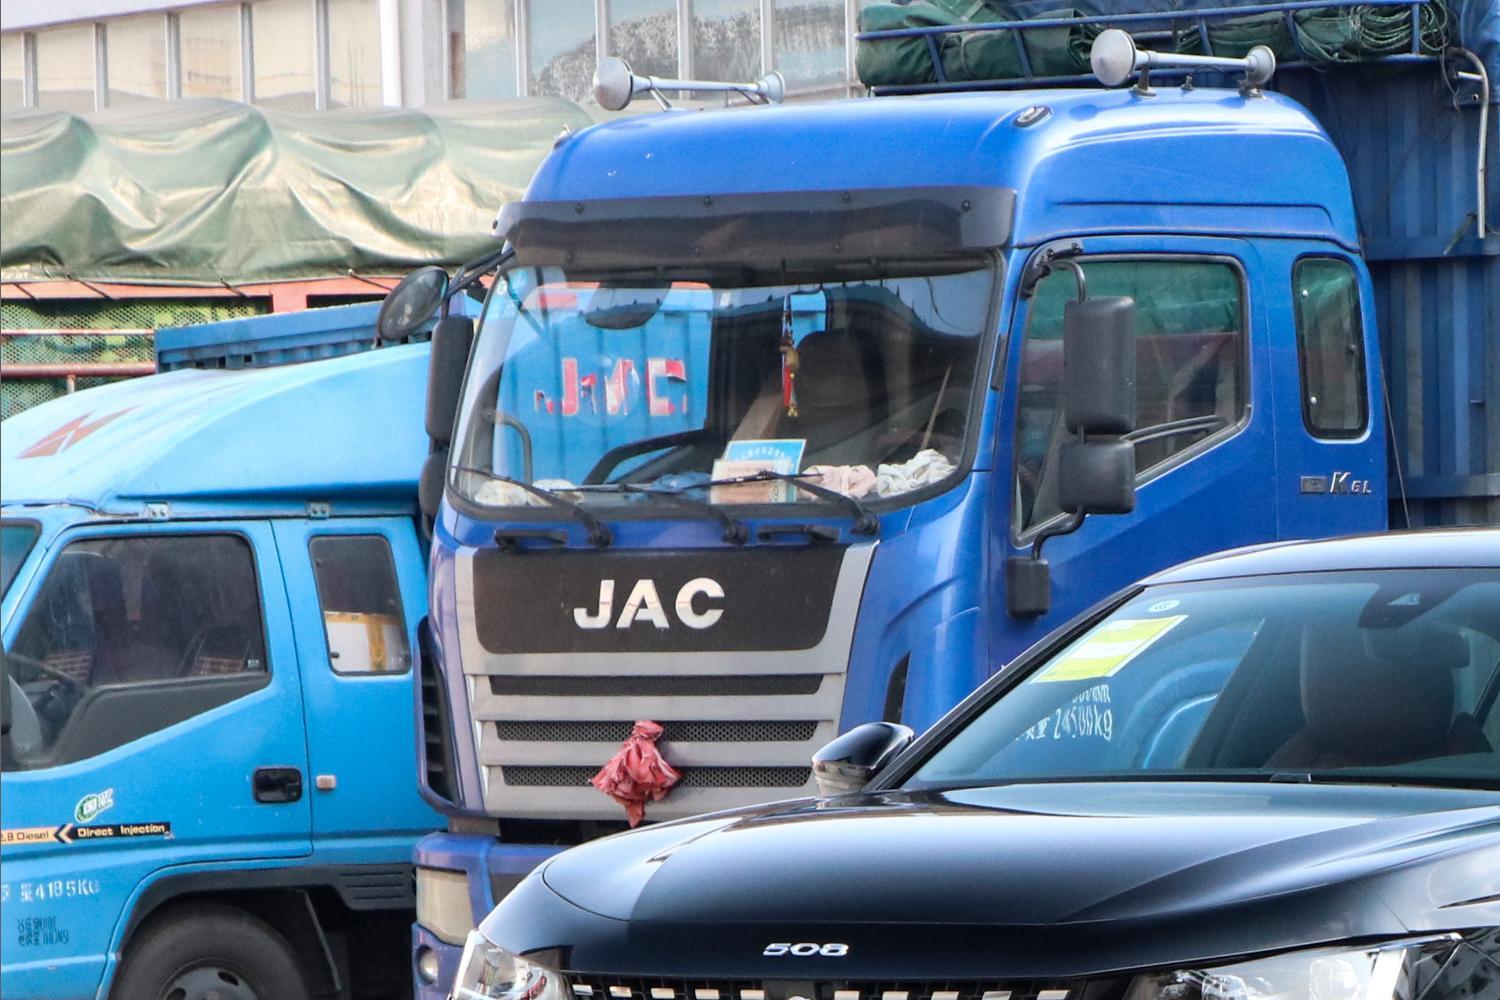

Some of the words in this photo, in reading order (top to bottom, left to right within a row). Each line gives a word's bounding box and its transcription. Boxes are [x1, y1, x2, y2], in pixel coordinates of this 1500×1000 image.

[573, 577, 725, 629] JAC
[17, 830, 49, 841] Diesel
[77, 826, 113, 838] Direct
[121, 823, 166, 837] Injection
[763, 943, 849, 956] 508
